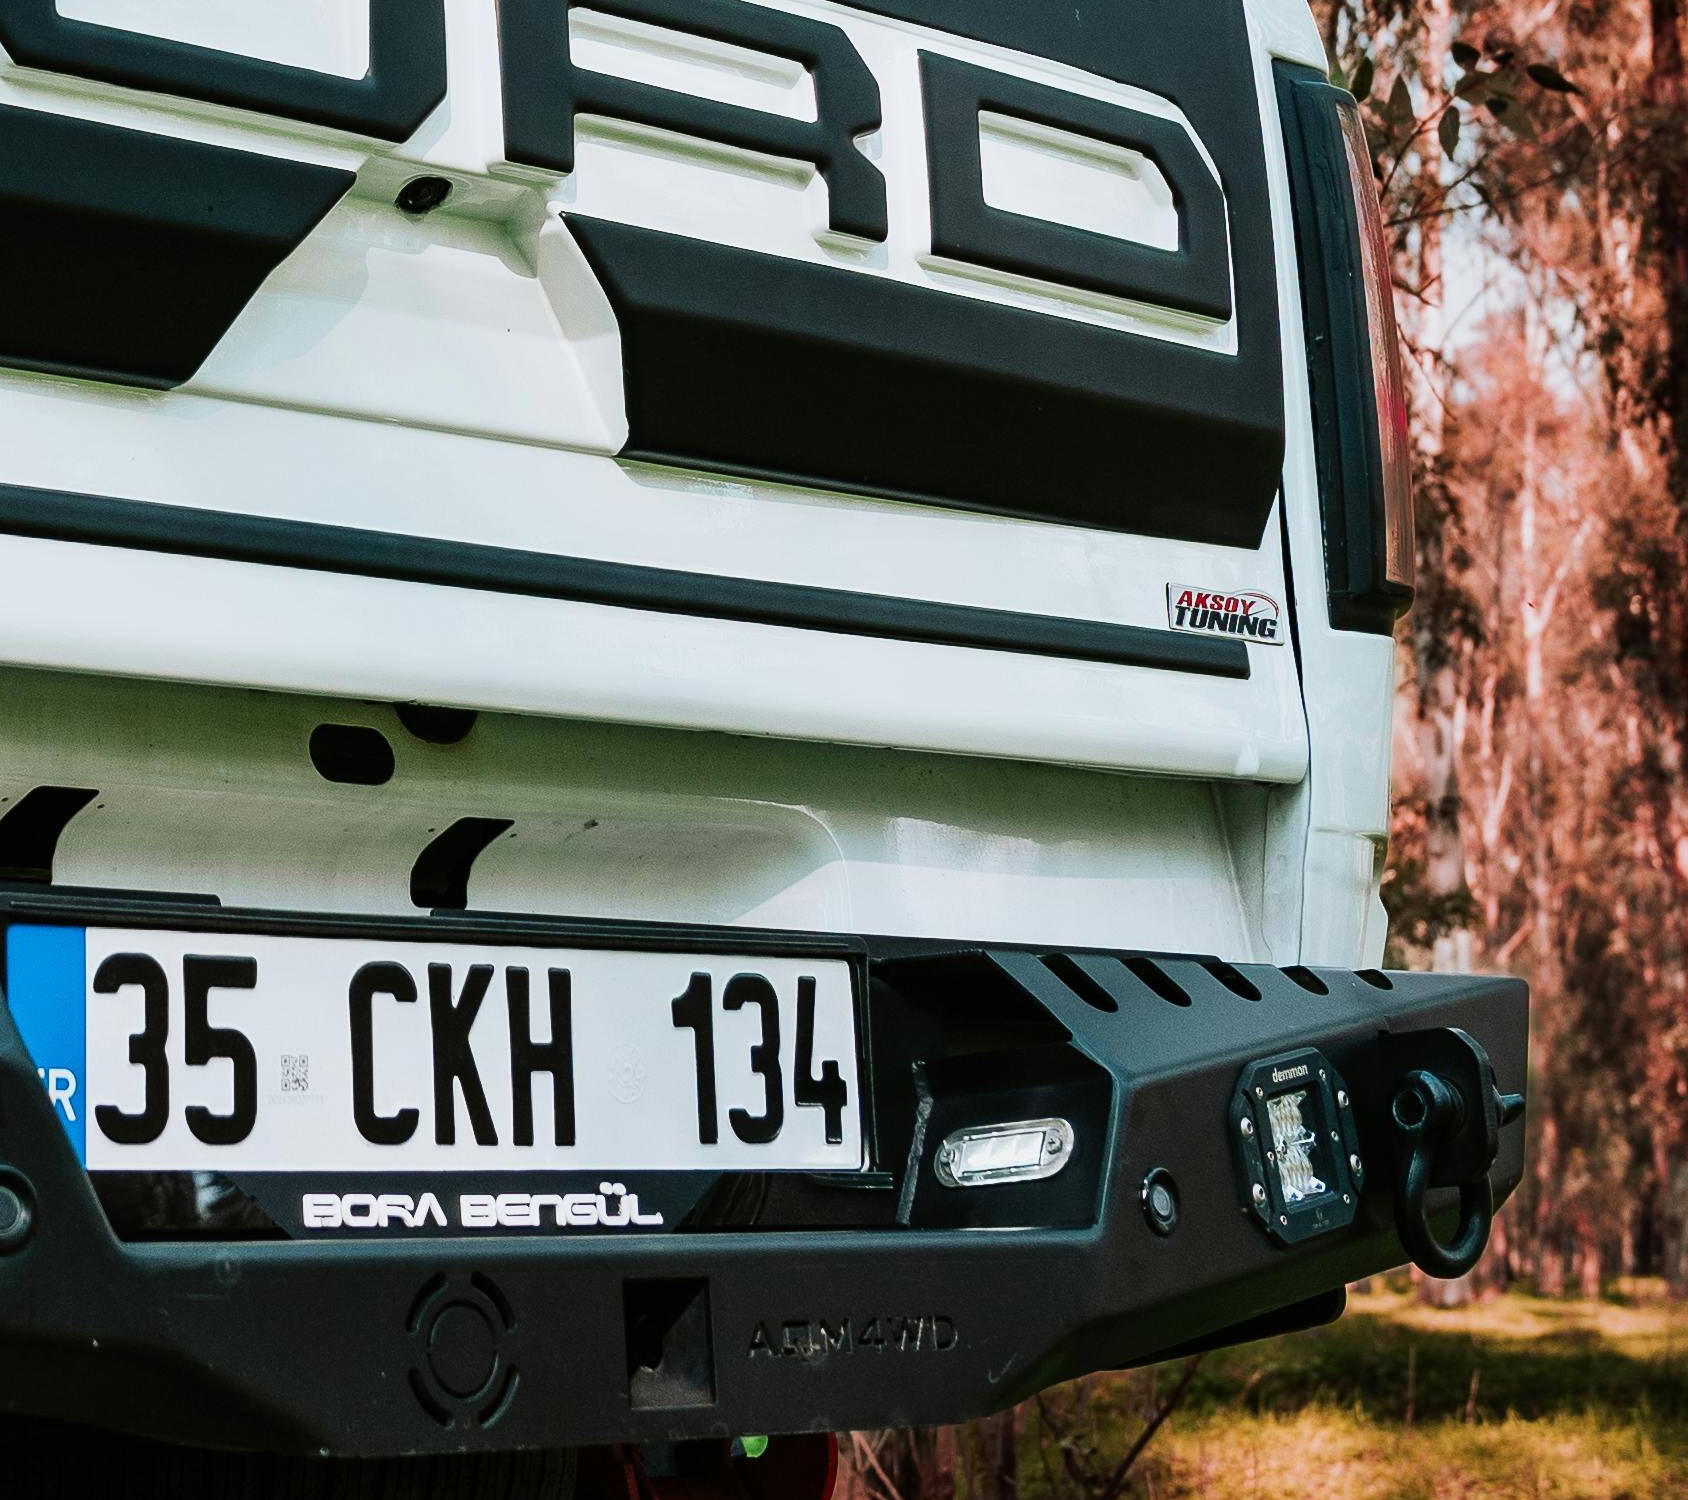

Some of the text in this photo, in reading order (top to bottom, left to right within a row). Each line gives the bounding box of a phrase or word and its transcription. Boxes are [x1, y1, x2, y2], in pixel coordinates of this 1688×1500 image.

[1175, 605, 1278, 639] TUNING
[1177, 590, 1256, 615] AKSOY
[93, 952, 848, 1147] 35 CKH 134
[1272, 1064, 1309, 1083] demmon
[37, 1067, 77, 1122] R
[302, 1181, 664, 1228] BORA BENGÜL
